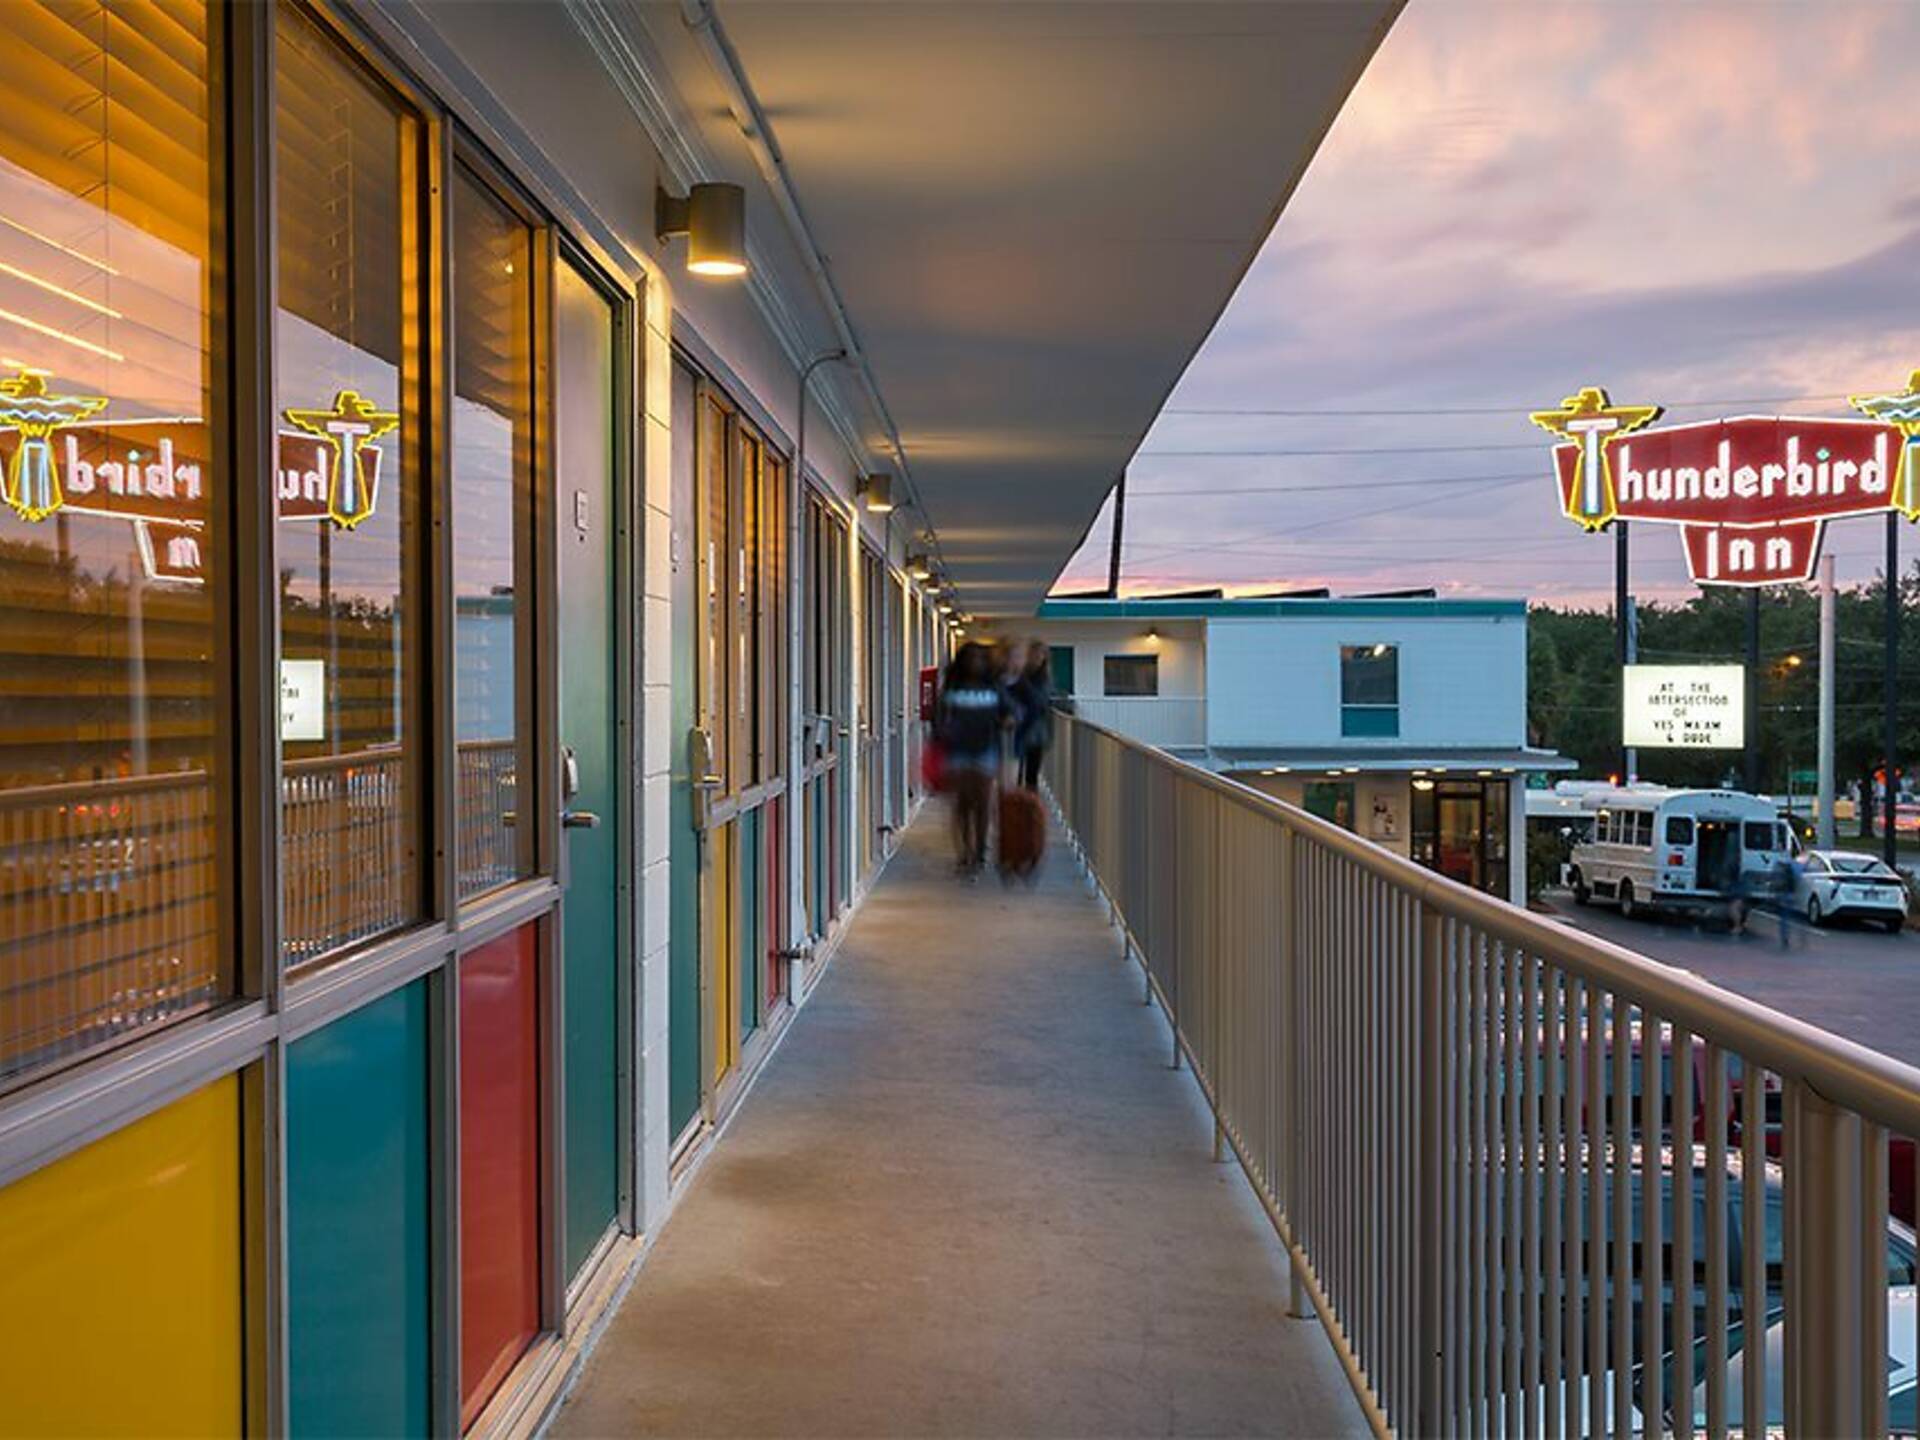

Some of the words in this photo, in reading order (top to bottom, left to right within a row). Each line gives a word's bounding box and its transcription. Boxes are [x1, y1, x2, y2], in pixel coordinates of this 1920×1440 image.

[1567, 418, 1888, 514] Thunderbird
[1707, 530, 1791, 579] Inn
[1660, 682, 1674, 693] AT
[1691, 682, 1710, 693] THE
[1648, 695, 1728, 705] INTERSECTION
[1673, 708, 1687, 718] OF
[1654, 720, 1674, 731] YES
[1683, 733, 1711, 743] DUDE
